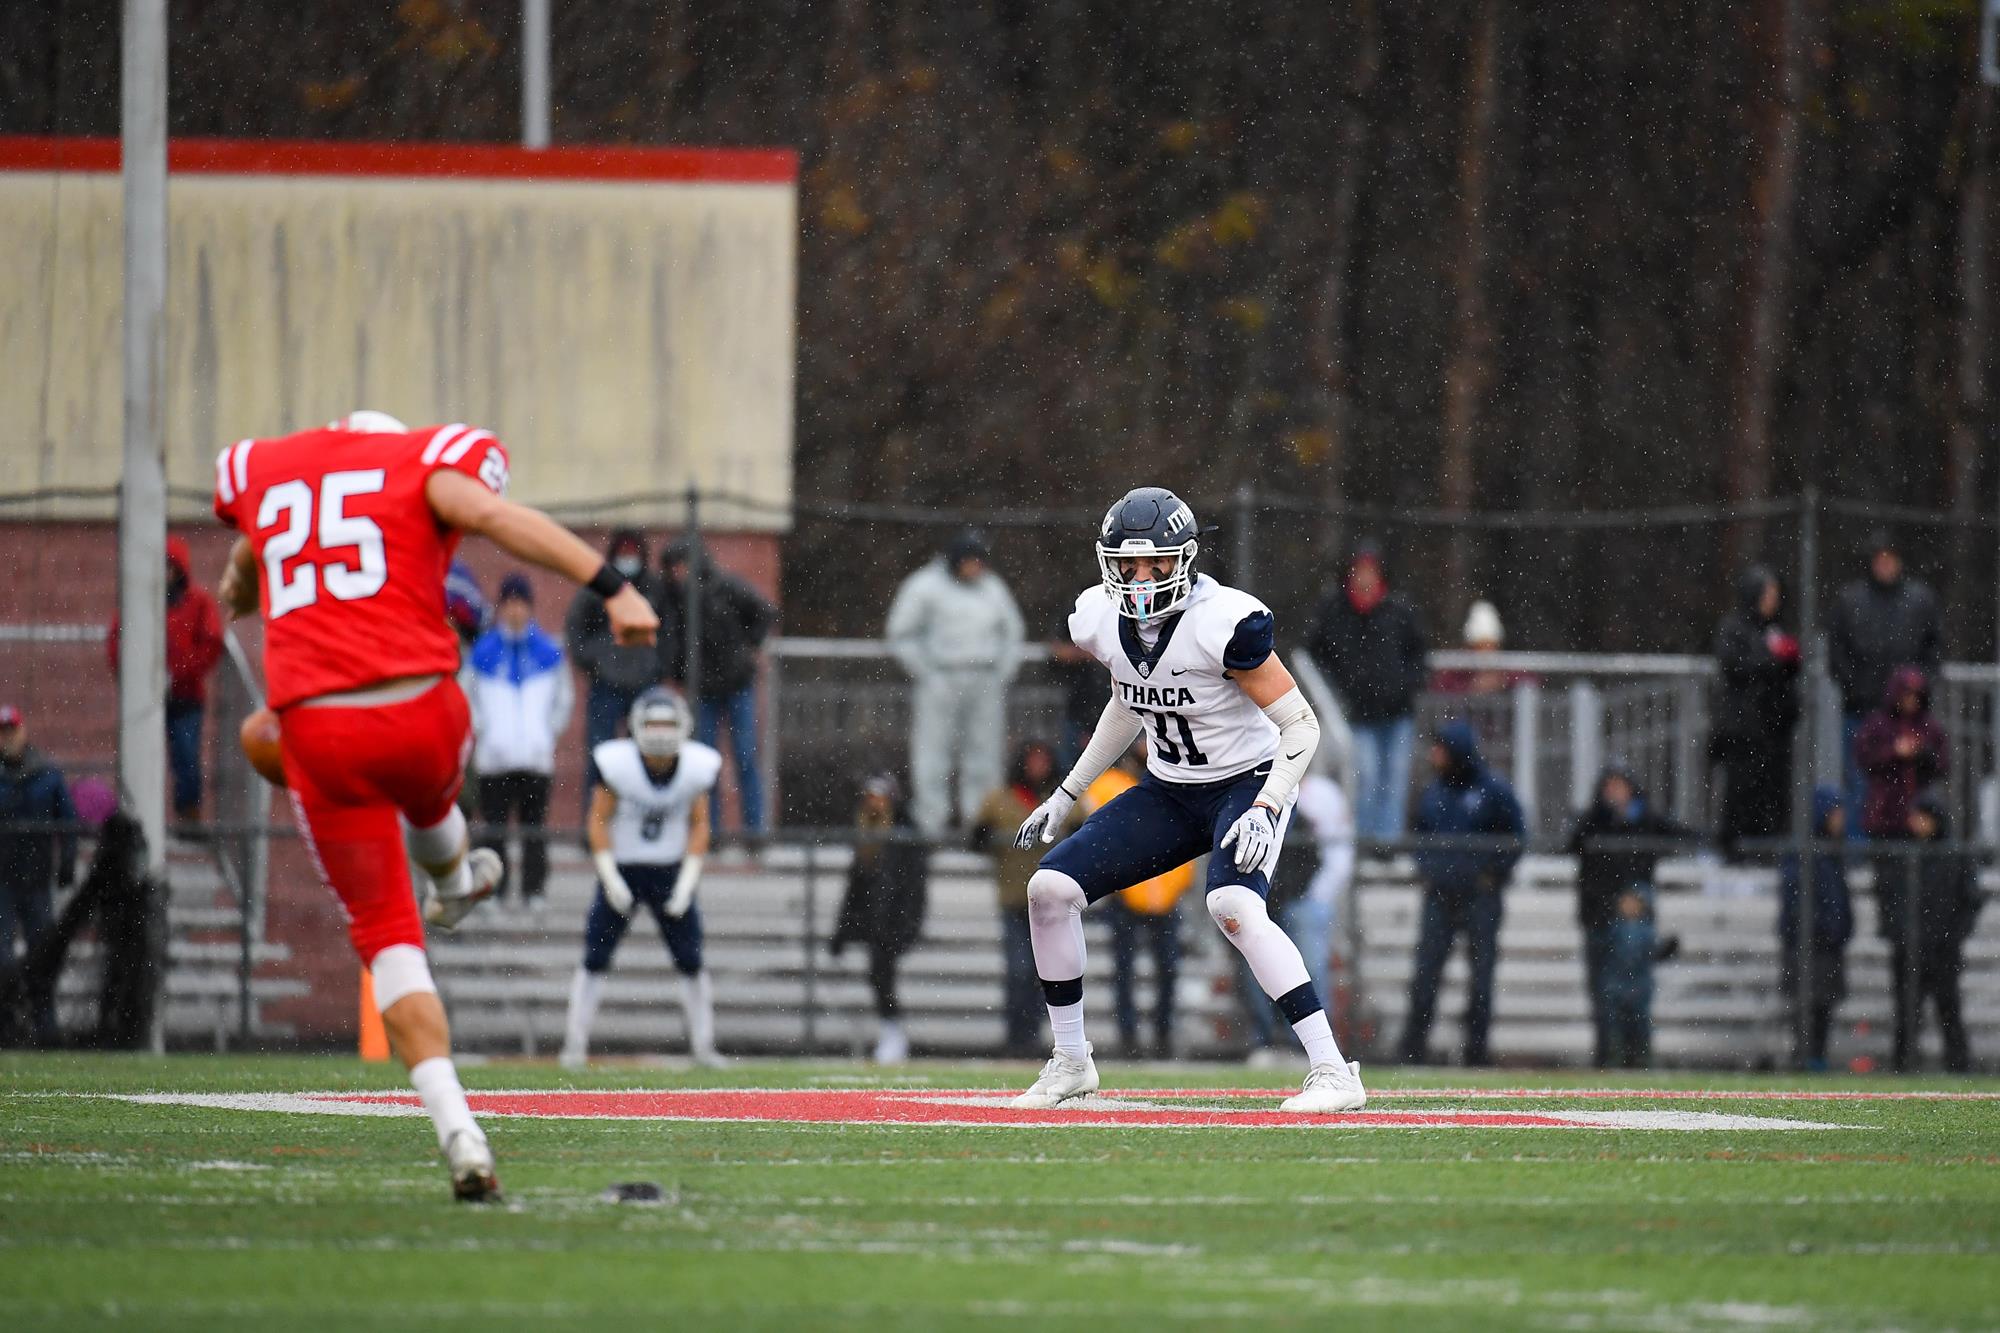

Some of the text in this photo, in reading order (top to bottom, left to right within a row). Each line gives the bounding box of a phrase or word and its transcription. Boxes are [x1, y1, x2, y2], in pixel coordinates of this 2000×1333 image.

[256, 469, 388, 619] 25
[1113, 679, 1196, 706] THACA
[1129, 706, 1209, 766] 31
